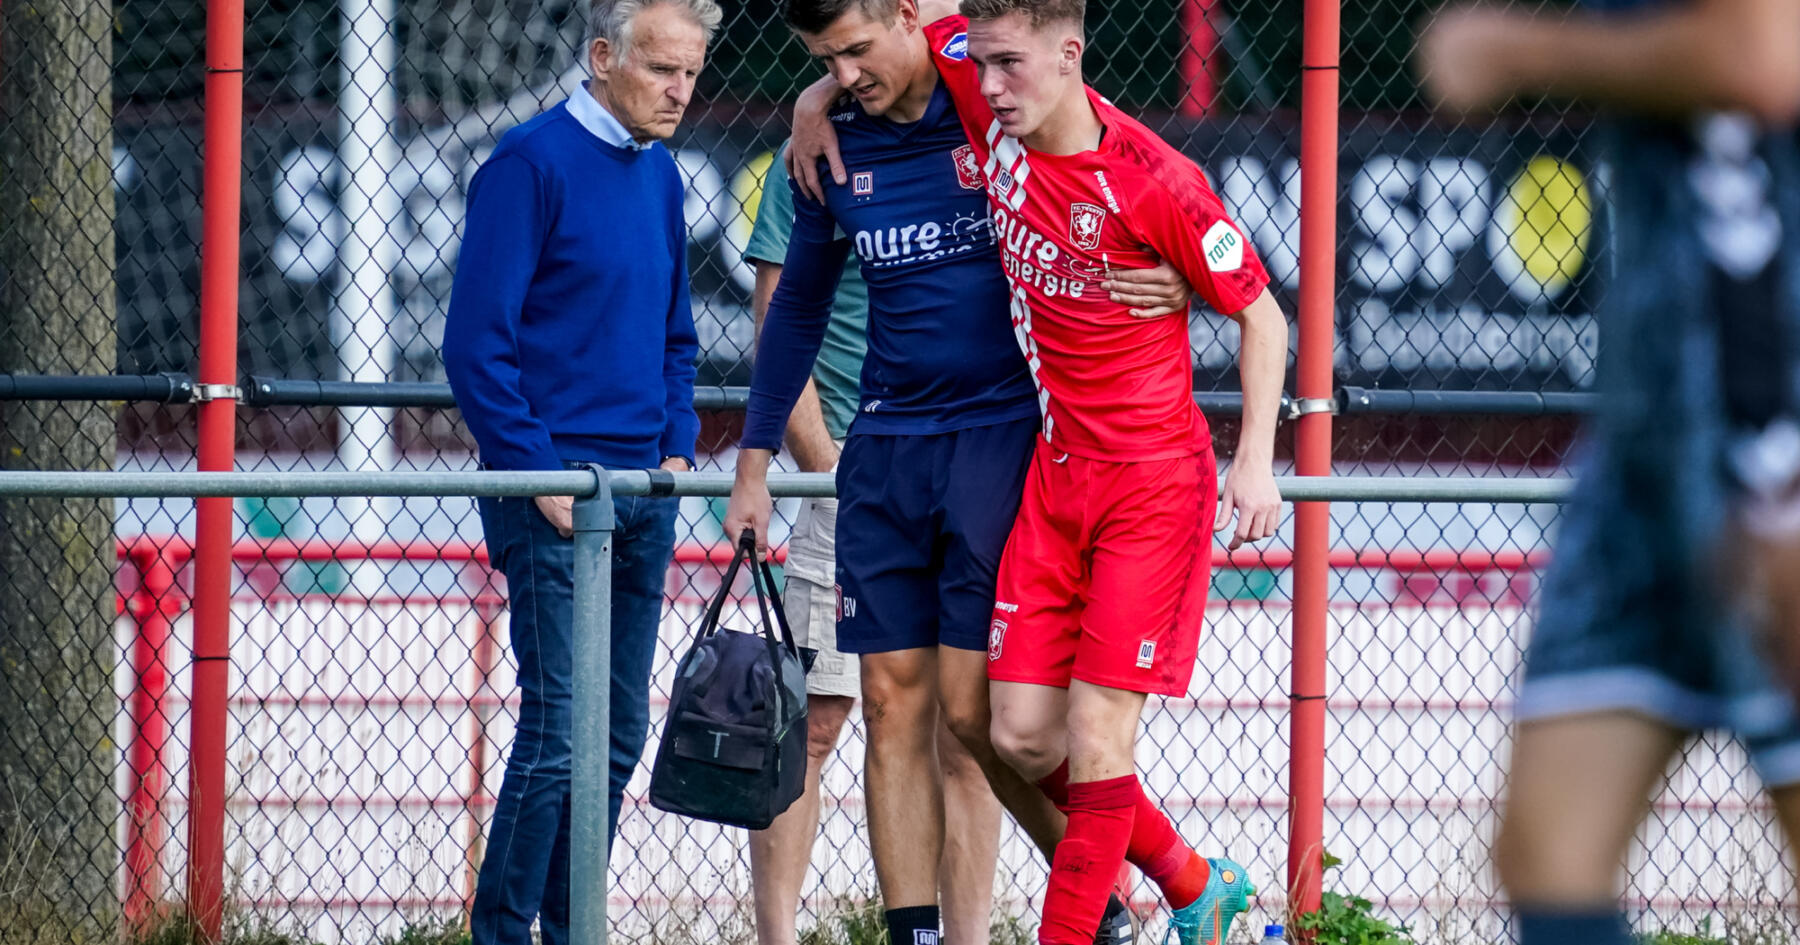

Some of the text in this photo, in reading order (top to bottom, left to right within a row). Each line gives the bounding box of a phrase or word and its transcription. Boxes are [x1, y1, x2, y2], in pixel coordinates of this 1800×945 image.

[1208, 232, 1236, 264] TOTO
[1003, 248, 1085, 298] energie
[843, 596, 856, 618] BV
